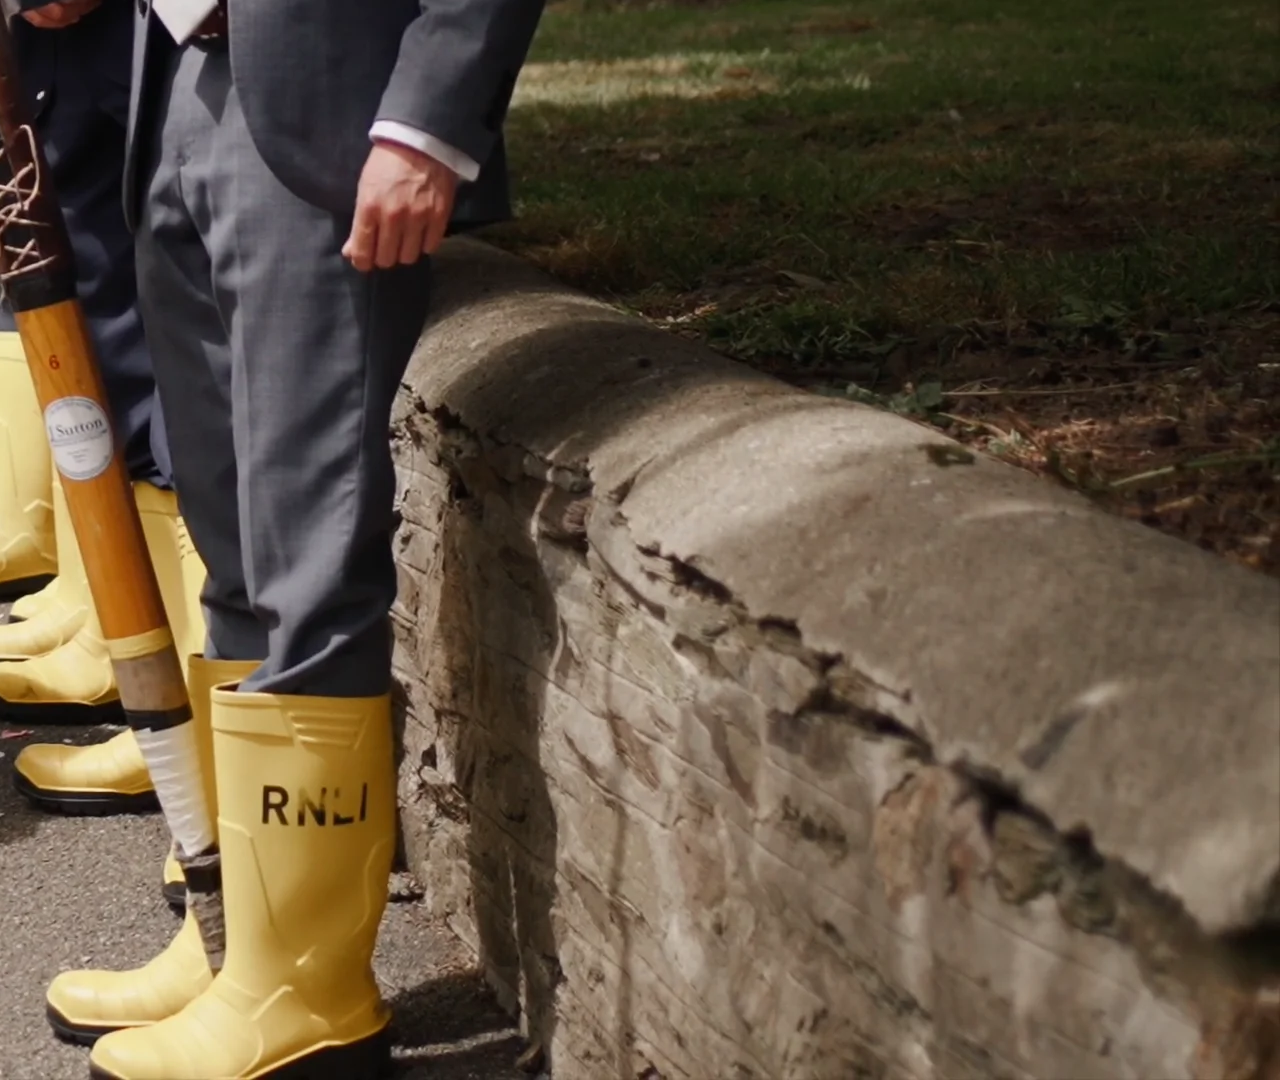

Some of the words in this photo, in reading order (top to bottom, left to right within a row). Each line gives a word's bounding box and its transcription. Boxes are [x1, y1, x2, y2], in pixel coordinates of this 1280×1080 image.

[49, 354, 60, 370] 6
[55, 418, 104, 439] Sutton
[262, 782, 368, 827] RNLI
